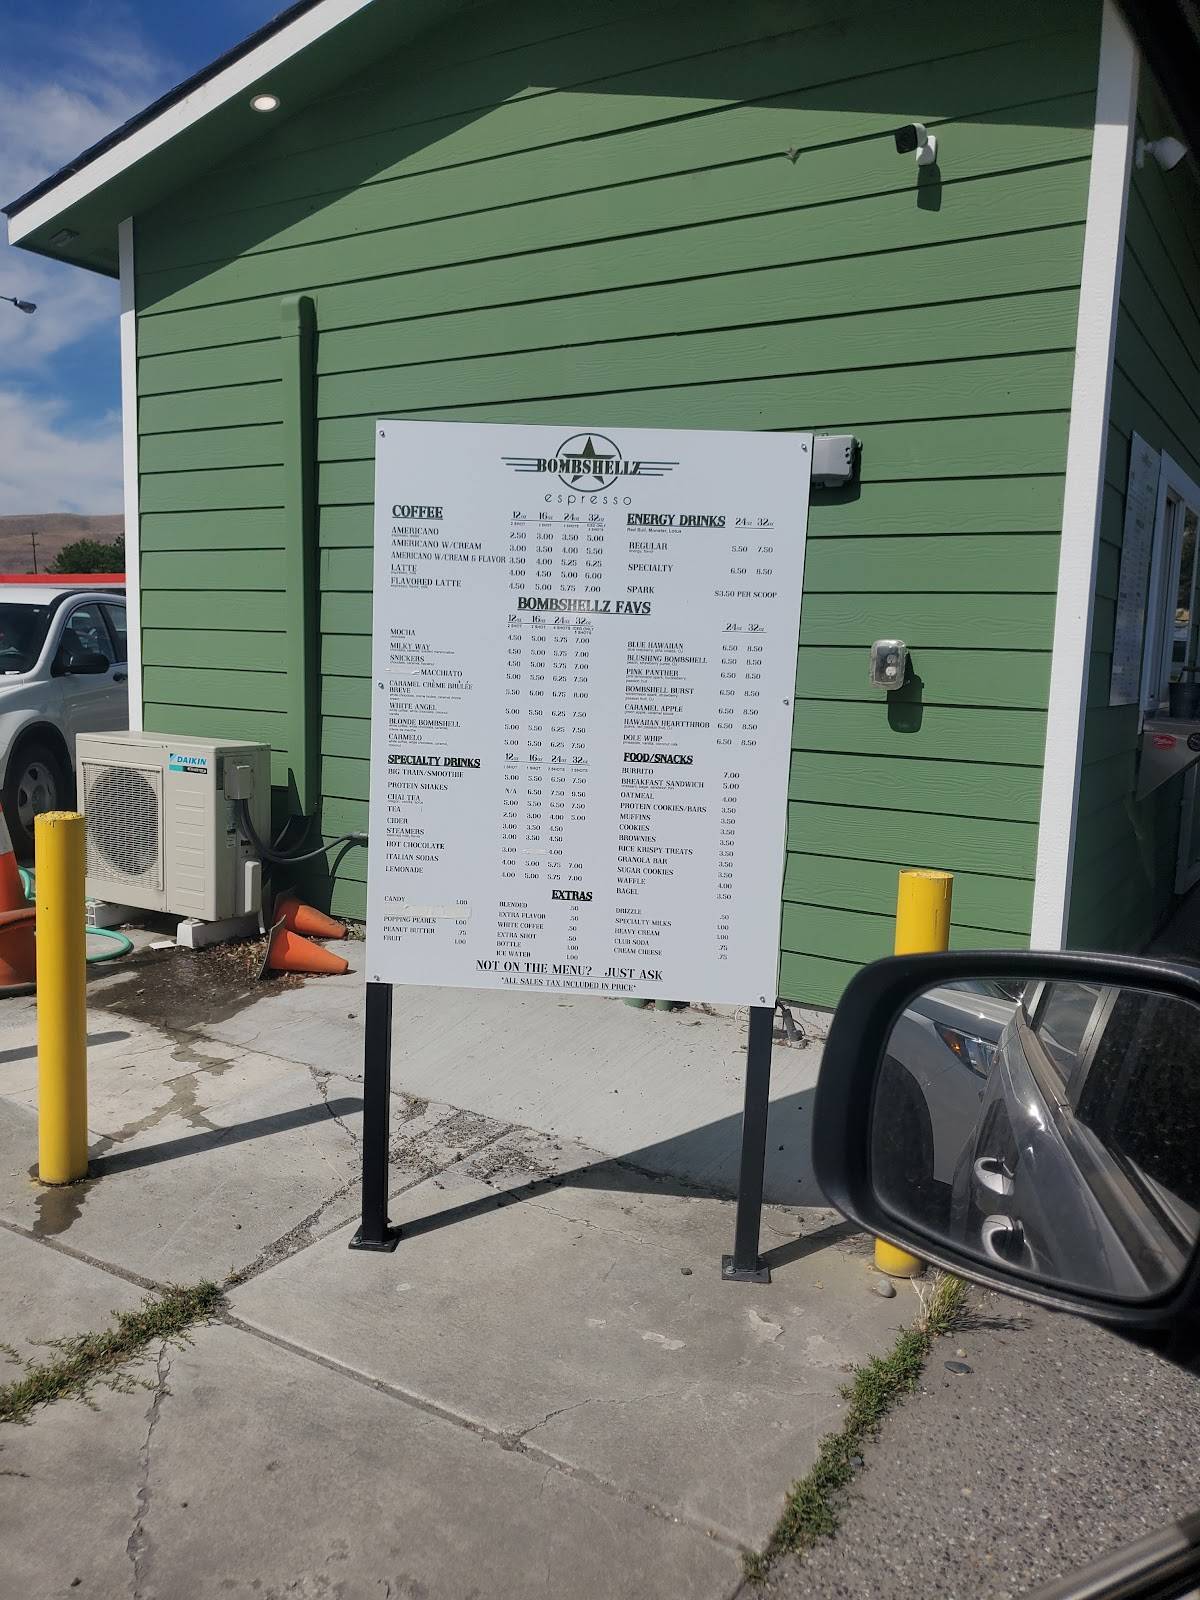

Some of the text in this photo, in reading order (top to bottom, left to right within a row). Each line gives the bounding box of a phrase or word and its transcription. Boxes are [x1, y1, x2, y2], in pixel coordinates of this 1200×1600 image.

[536, 458, 641, 476] BOMBSHELLZ
[545, 494, 631, 506] espresso
[392, 505, 443, 519] COFFEE
[627, 513, 725, 527] ENERGY DRINKS
[392, 527, 438, 536] AMERICANO
[630, 542, 667, 550] REGULAR
[479, 555, 505, 563] FLAVOR
[391, 564, 416, 573] LATTE
[628, 564, 673, 572] SPECIALTY
[391, 578, 432, 587] FLAVORED
[436, 579, 461, 587] LATTE
[517, 597, 651, 615] BOMBSHELLZ FAVS
[390, 642, 413, 651] MILKY
[390, 655, 424, 663] SNICKERS
[627, 655, 661, 663] BLUSHING
[663, 656, 707, 664] BOMBSHELL
[421, 669, 462, 677] MACCHIATO
[646, 669, 678, 677] PANTHER
[625, 686, 668, 694] BOMBSHELL
[390, 702, 412, 710] WHITE
[625, 704, 658, 712] CARAMEL
[389, 718, 460, 728] BLONDE BOMBSHELL
[660, 720, 709, 729] HEARTTHROB
[177, 756, 207, 766] DAIKIN
[388, 755, 480, 768] SPECIALTY DRINKS
[624, 752, 693, 765] FOOD/SNACKS
[404, 769, 463, 777] TRAIN/SMOOTHIE
[622, 778, 663, 787] BREAKFAST
[664, 780, 703, 789] SANDWICH
[387, 828, 424, 836] STEAMERS
[552, 890, 592, 901] EXTRAS
[476, 960, 662, 980] NOT ON THE MENU? JUST ASK
[561, 981, 599, 989] INCLUDED
